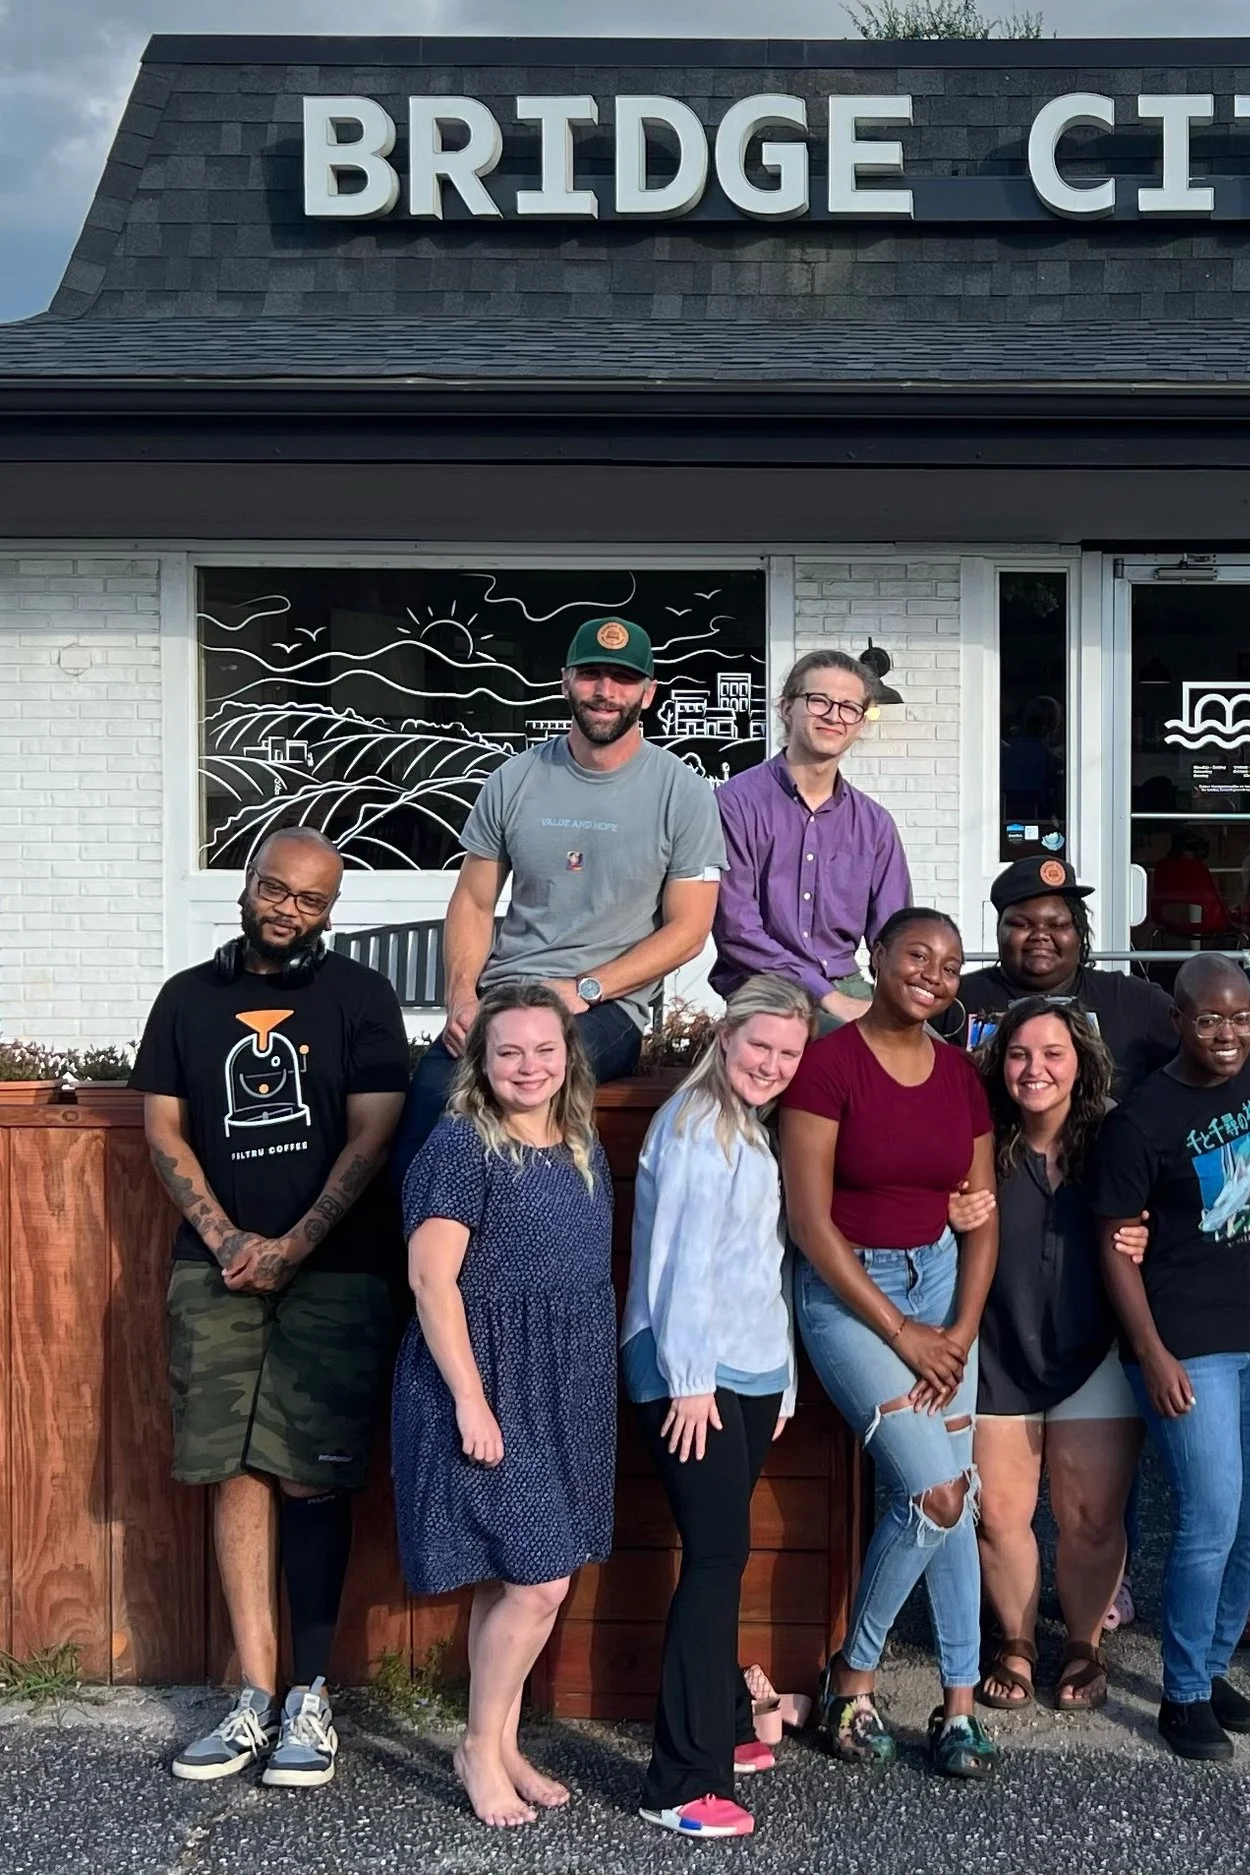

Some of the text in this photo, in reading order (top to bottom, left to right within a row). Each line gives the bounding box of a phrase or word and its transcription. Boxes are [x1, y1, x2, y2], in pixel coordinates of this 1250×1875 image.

[302, 93, 914, 220] BRIDGE
[541, 817, 619, 832] VALUE AND HOPE
[231, 1141, 308, 1160] FILTRU COFFEE
